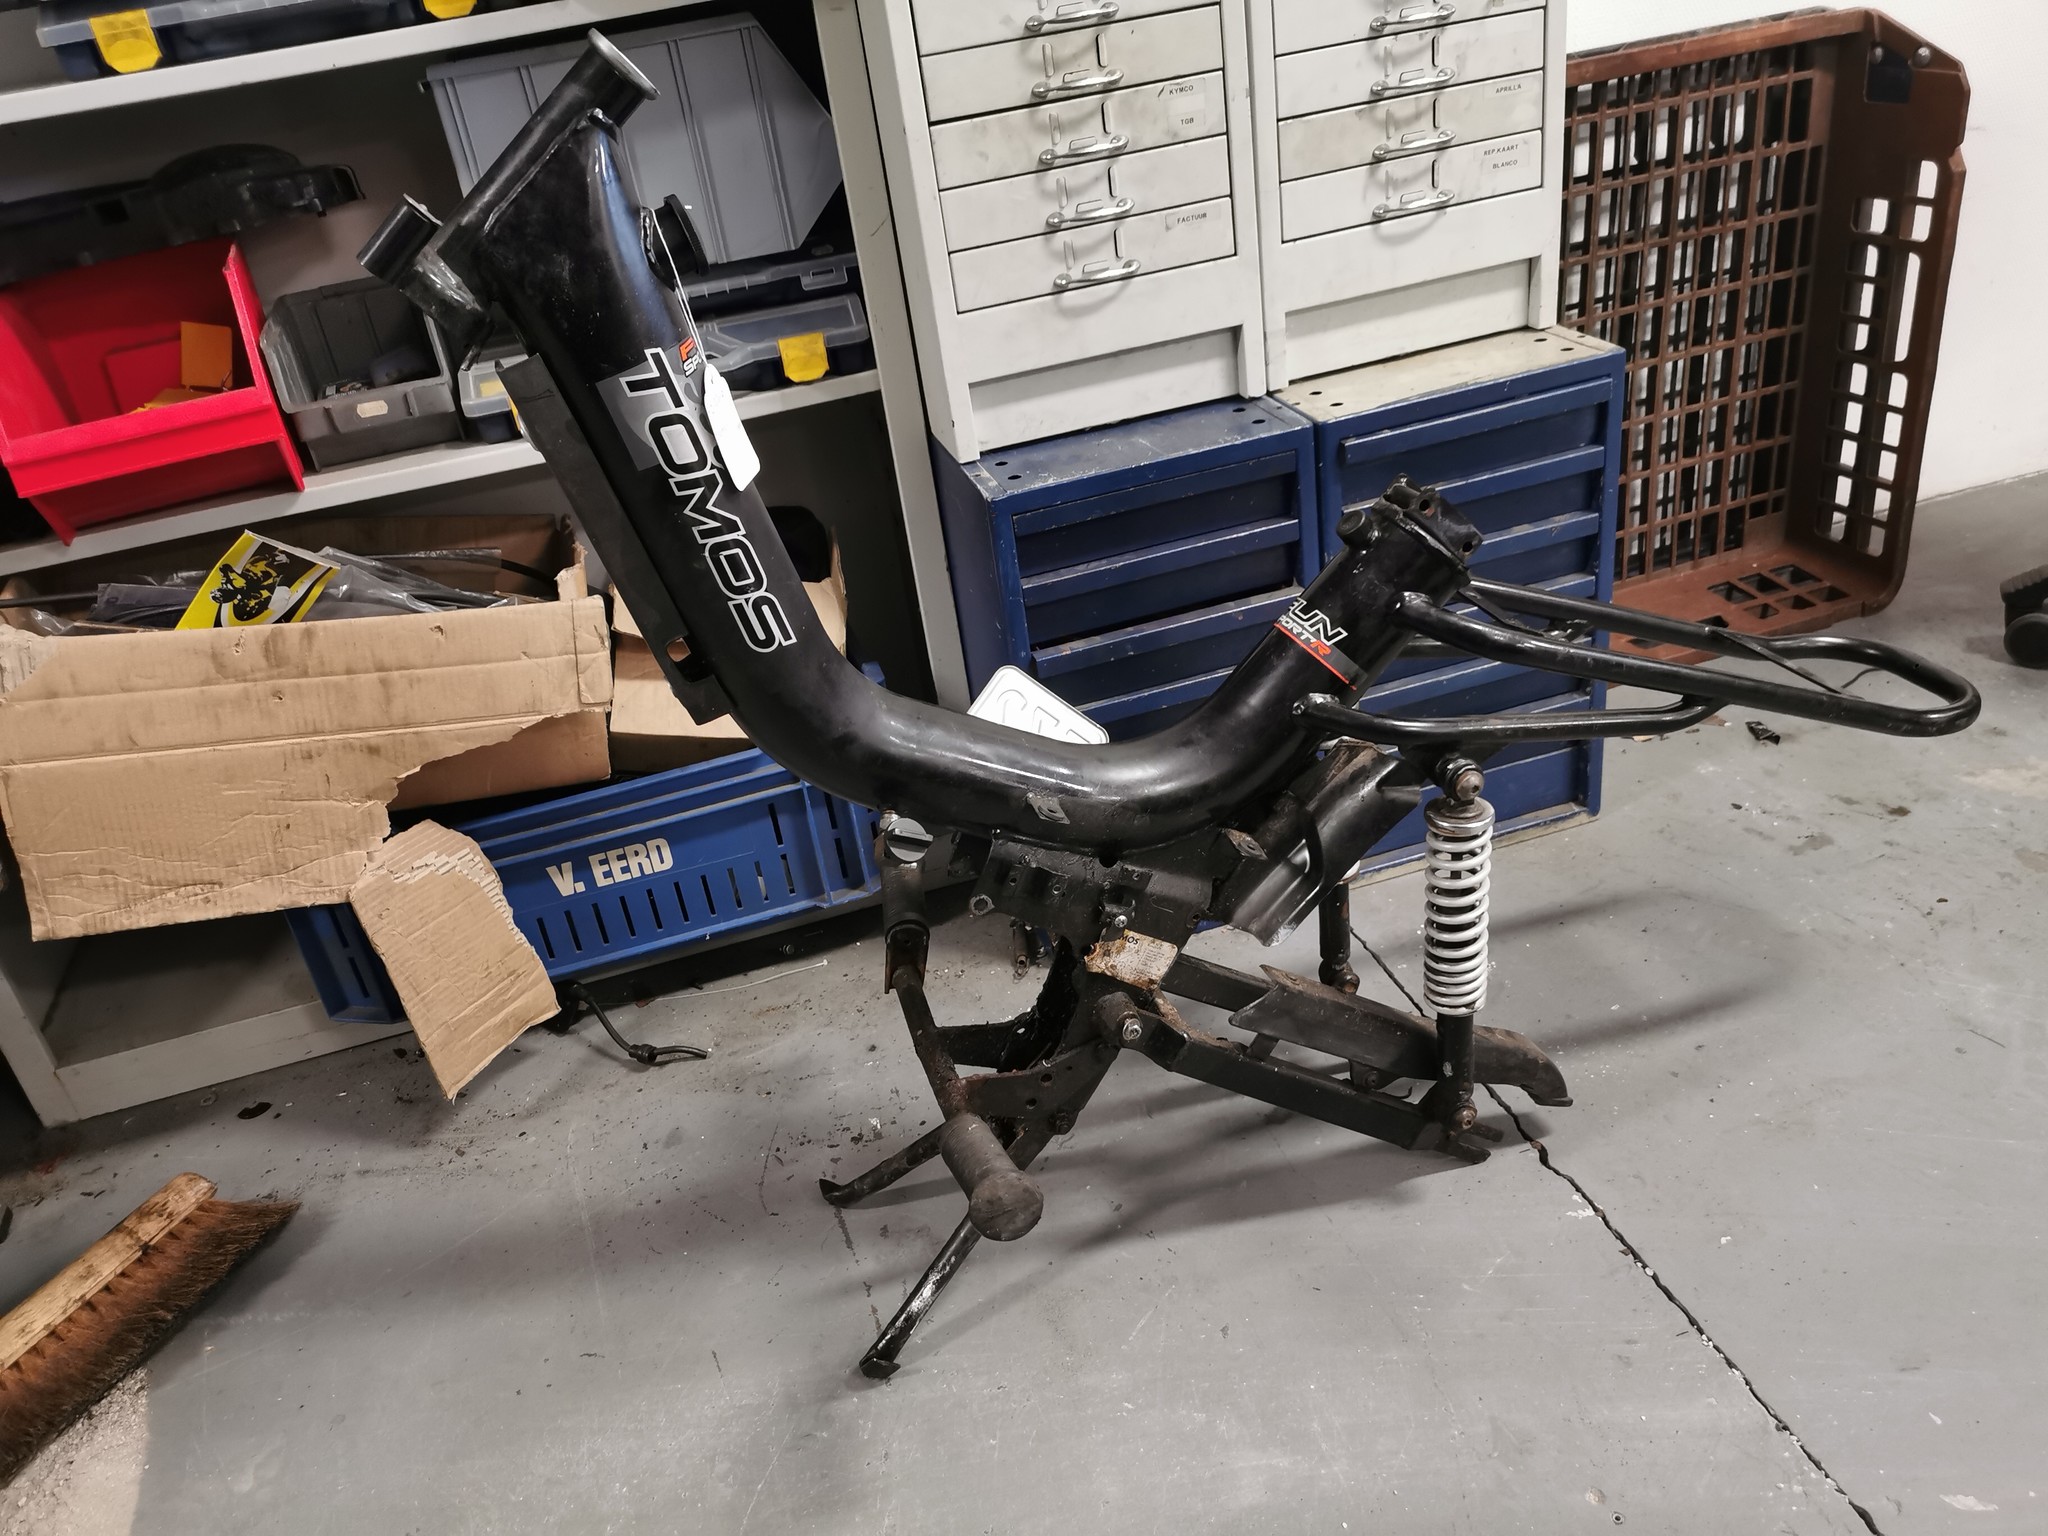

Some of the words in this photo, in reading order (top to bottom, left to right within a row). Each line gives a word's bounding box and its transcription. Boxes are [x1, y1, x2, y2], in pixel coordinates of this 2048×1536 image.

[1168, 85, 1194, 95] KYMCO
[1180, 117, 1194, 125] TGB
[1492, 159, 1518, 169] BLANCO
[1177, 212, 1208, 224] FACTUUR
[618, 347, 798, 653] TOMOS
[1288, 597, 1348, 646] UN
[545, 861, 586, 897] V.
[588, 837, 674, 887] EERD
